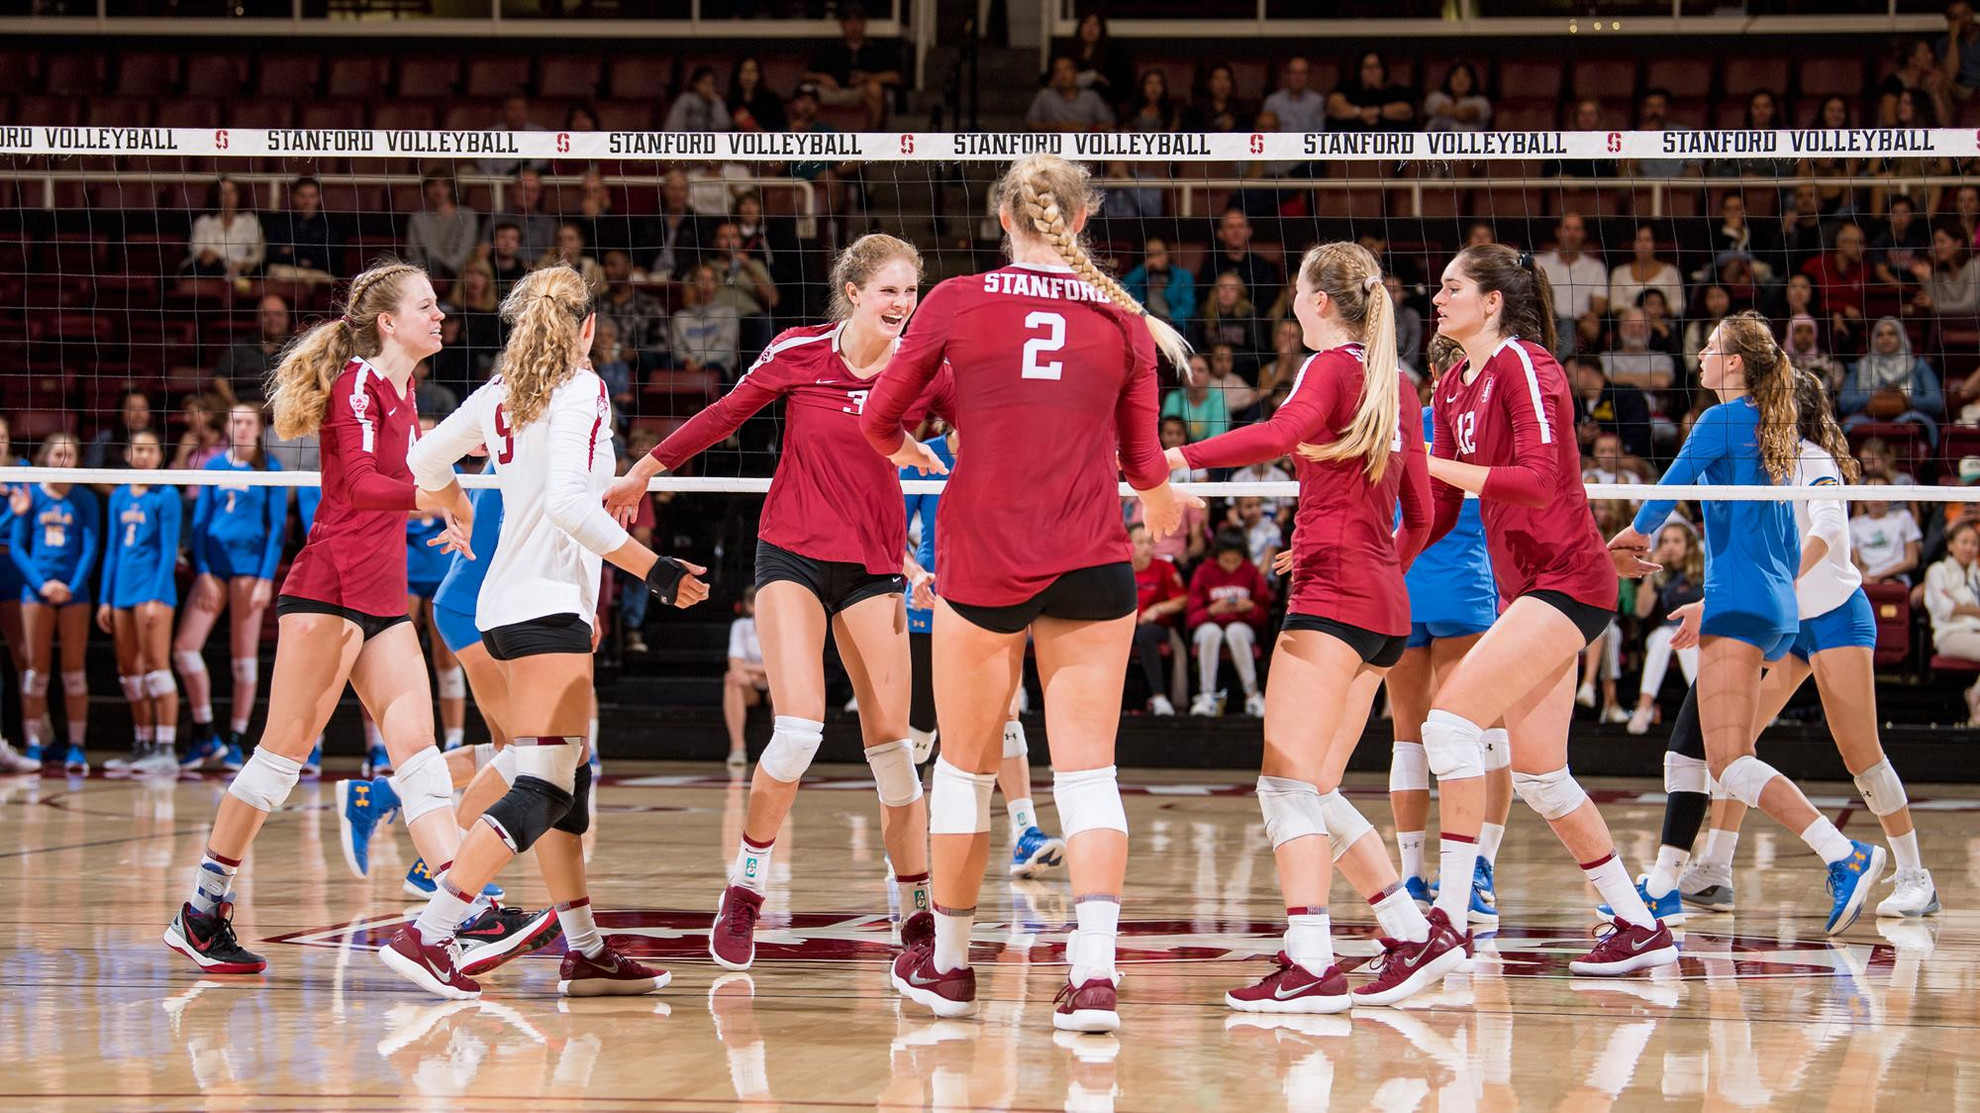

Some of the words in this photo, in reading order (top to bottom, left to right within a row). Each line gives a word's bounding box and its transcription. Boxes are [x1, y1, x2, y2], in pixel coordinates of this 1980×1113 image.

[45, 128, 178, 149] VOLLEYBALL
[268, 130, 373, 151] STANFORD
[386, 131, 519, 153] VOLLEYBALL
[609, 133, 715, 154] STANFORD
[728, 134, 862, 155] VOLLEYBALL
[954, 134, 1061, 155] STANFORD
[1076, 134, 1211, 155] VOLLEYBALL
[1304, 133, 1414, 155] STANFORD
[1426, 132, 1567, 154] VOLLEYBALL
[1663, 131, 1776, 153] STANFORD
[1791, 129, 1935, 152] VOLLEYBALL
[1021, 311, 1066, 380] 2
[843, 390, 869, 415] 3
[1457, 410, 1476, 455] 12
